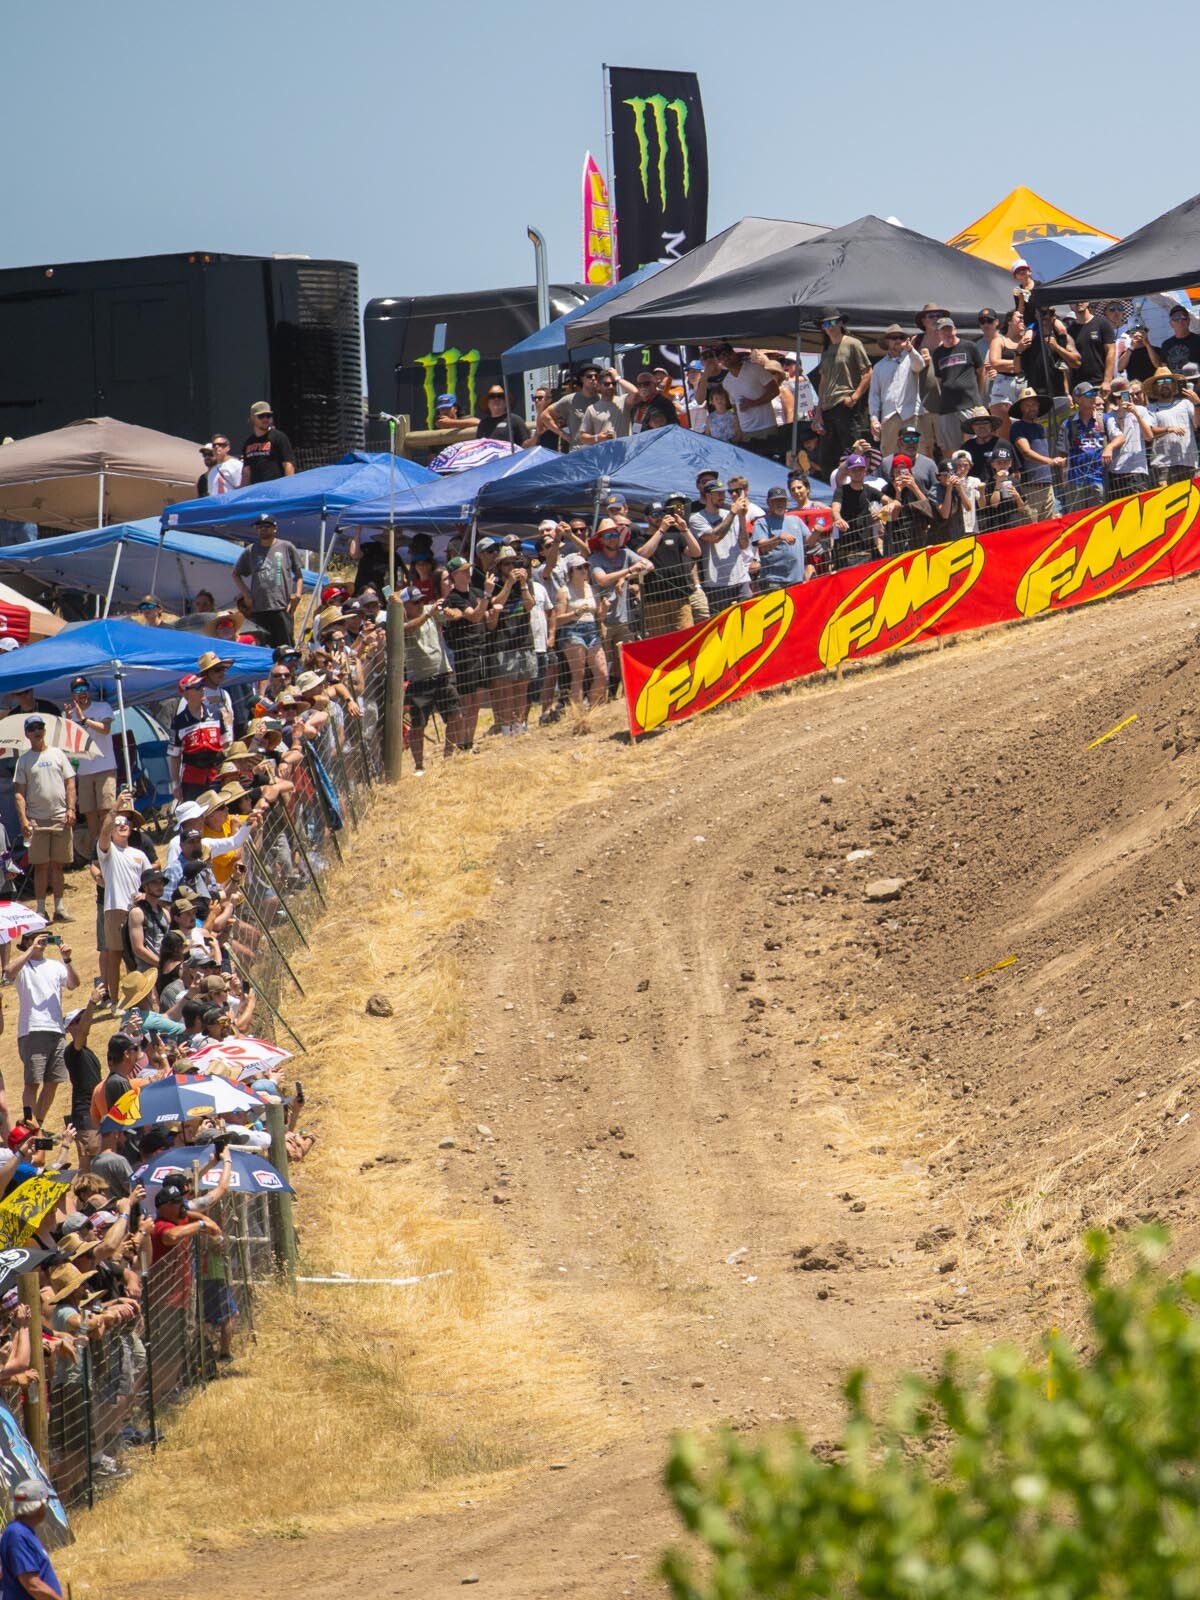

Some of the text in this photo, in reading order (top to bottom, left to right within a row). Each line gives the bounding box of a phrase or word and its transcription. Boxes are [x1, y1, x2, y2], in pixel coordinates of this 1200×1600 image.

[826, 535, 977, 669] FMF
[1024, 479, 1192, 617] FMF
[644, 588, 786, 732] FMF
[156, 1113, 179, 1122] USA
